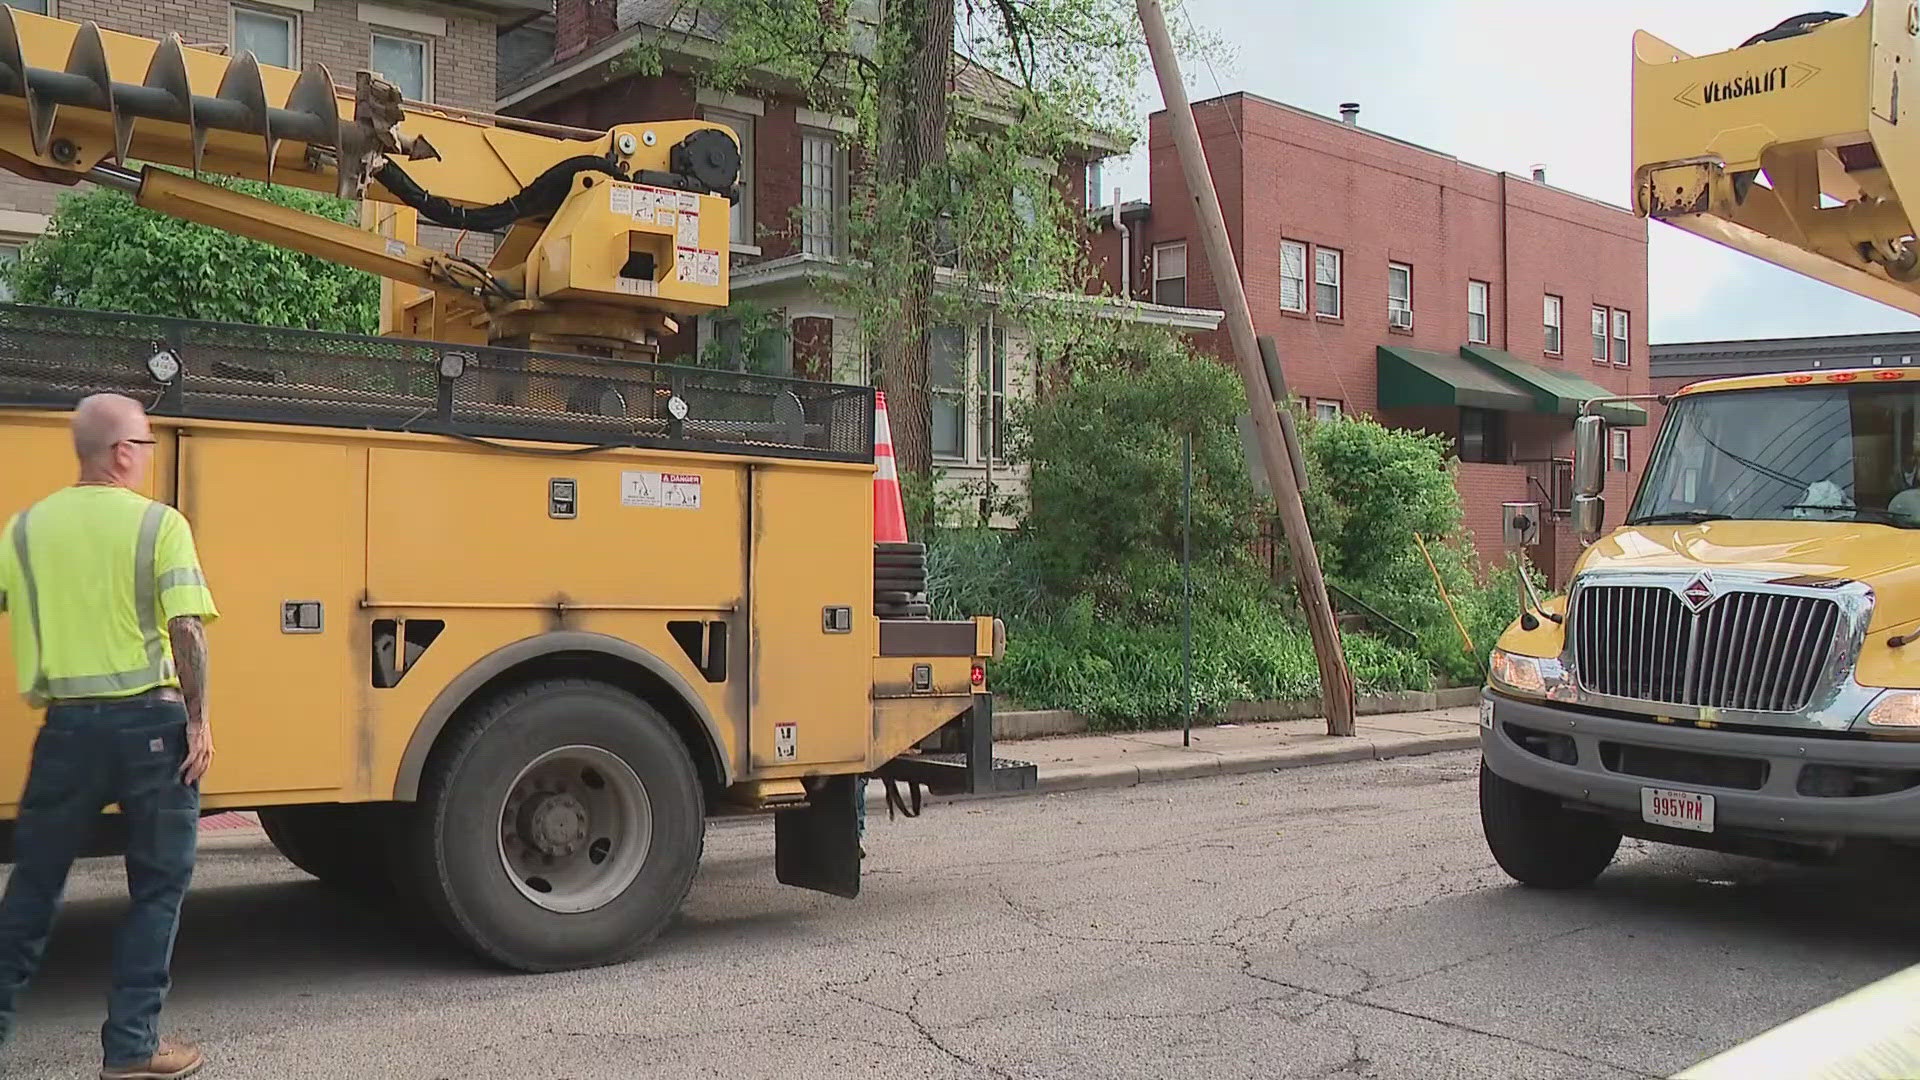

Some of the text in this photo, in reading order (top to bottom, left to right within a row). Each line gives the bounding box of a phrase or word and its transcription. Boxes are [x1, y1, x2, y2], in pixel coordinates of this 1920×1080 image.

[1703, 65, 1789, 104] VERSALIFT
[670, 474, 699, 484] DANGER
[1667, 791, 1687, 799] OHIO
